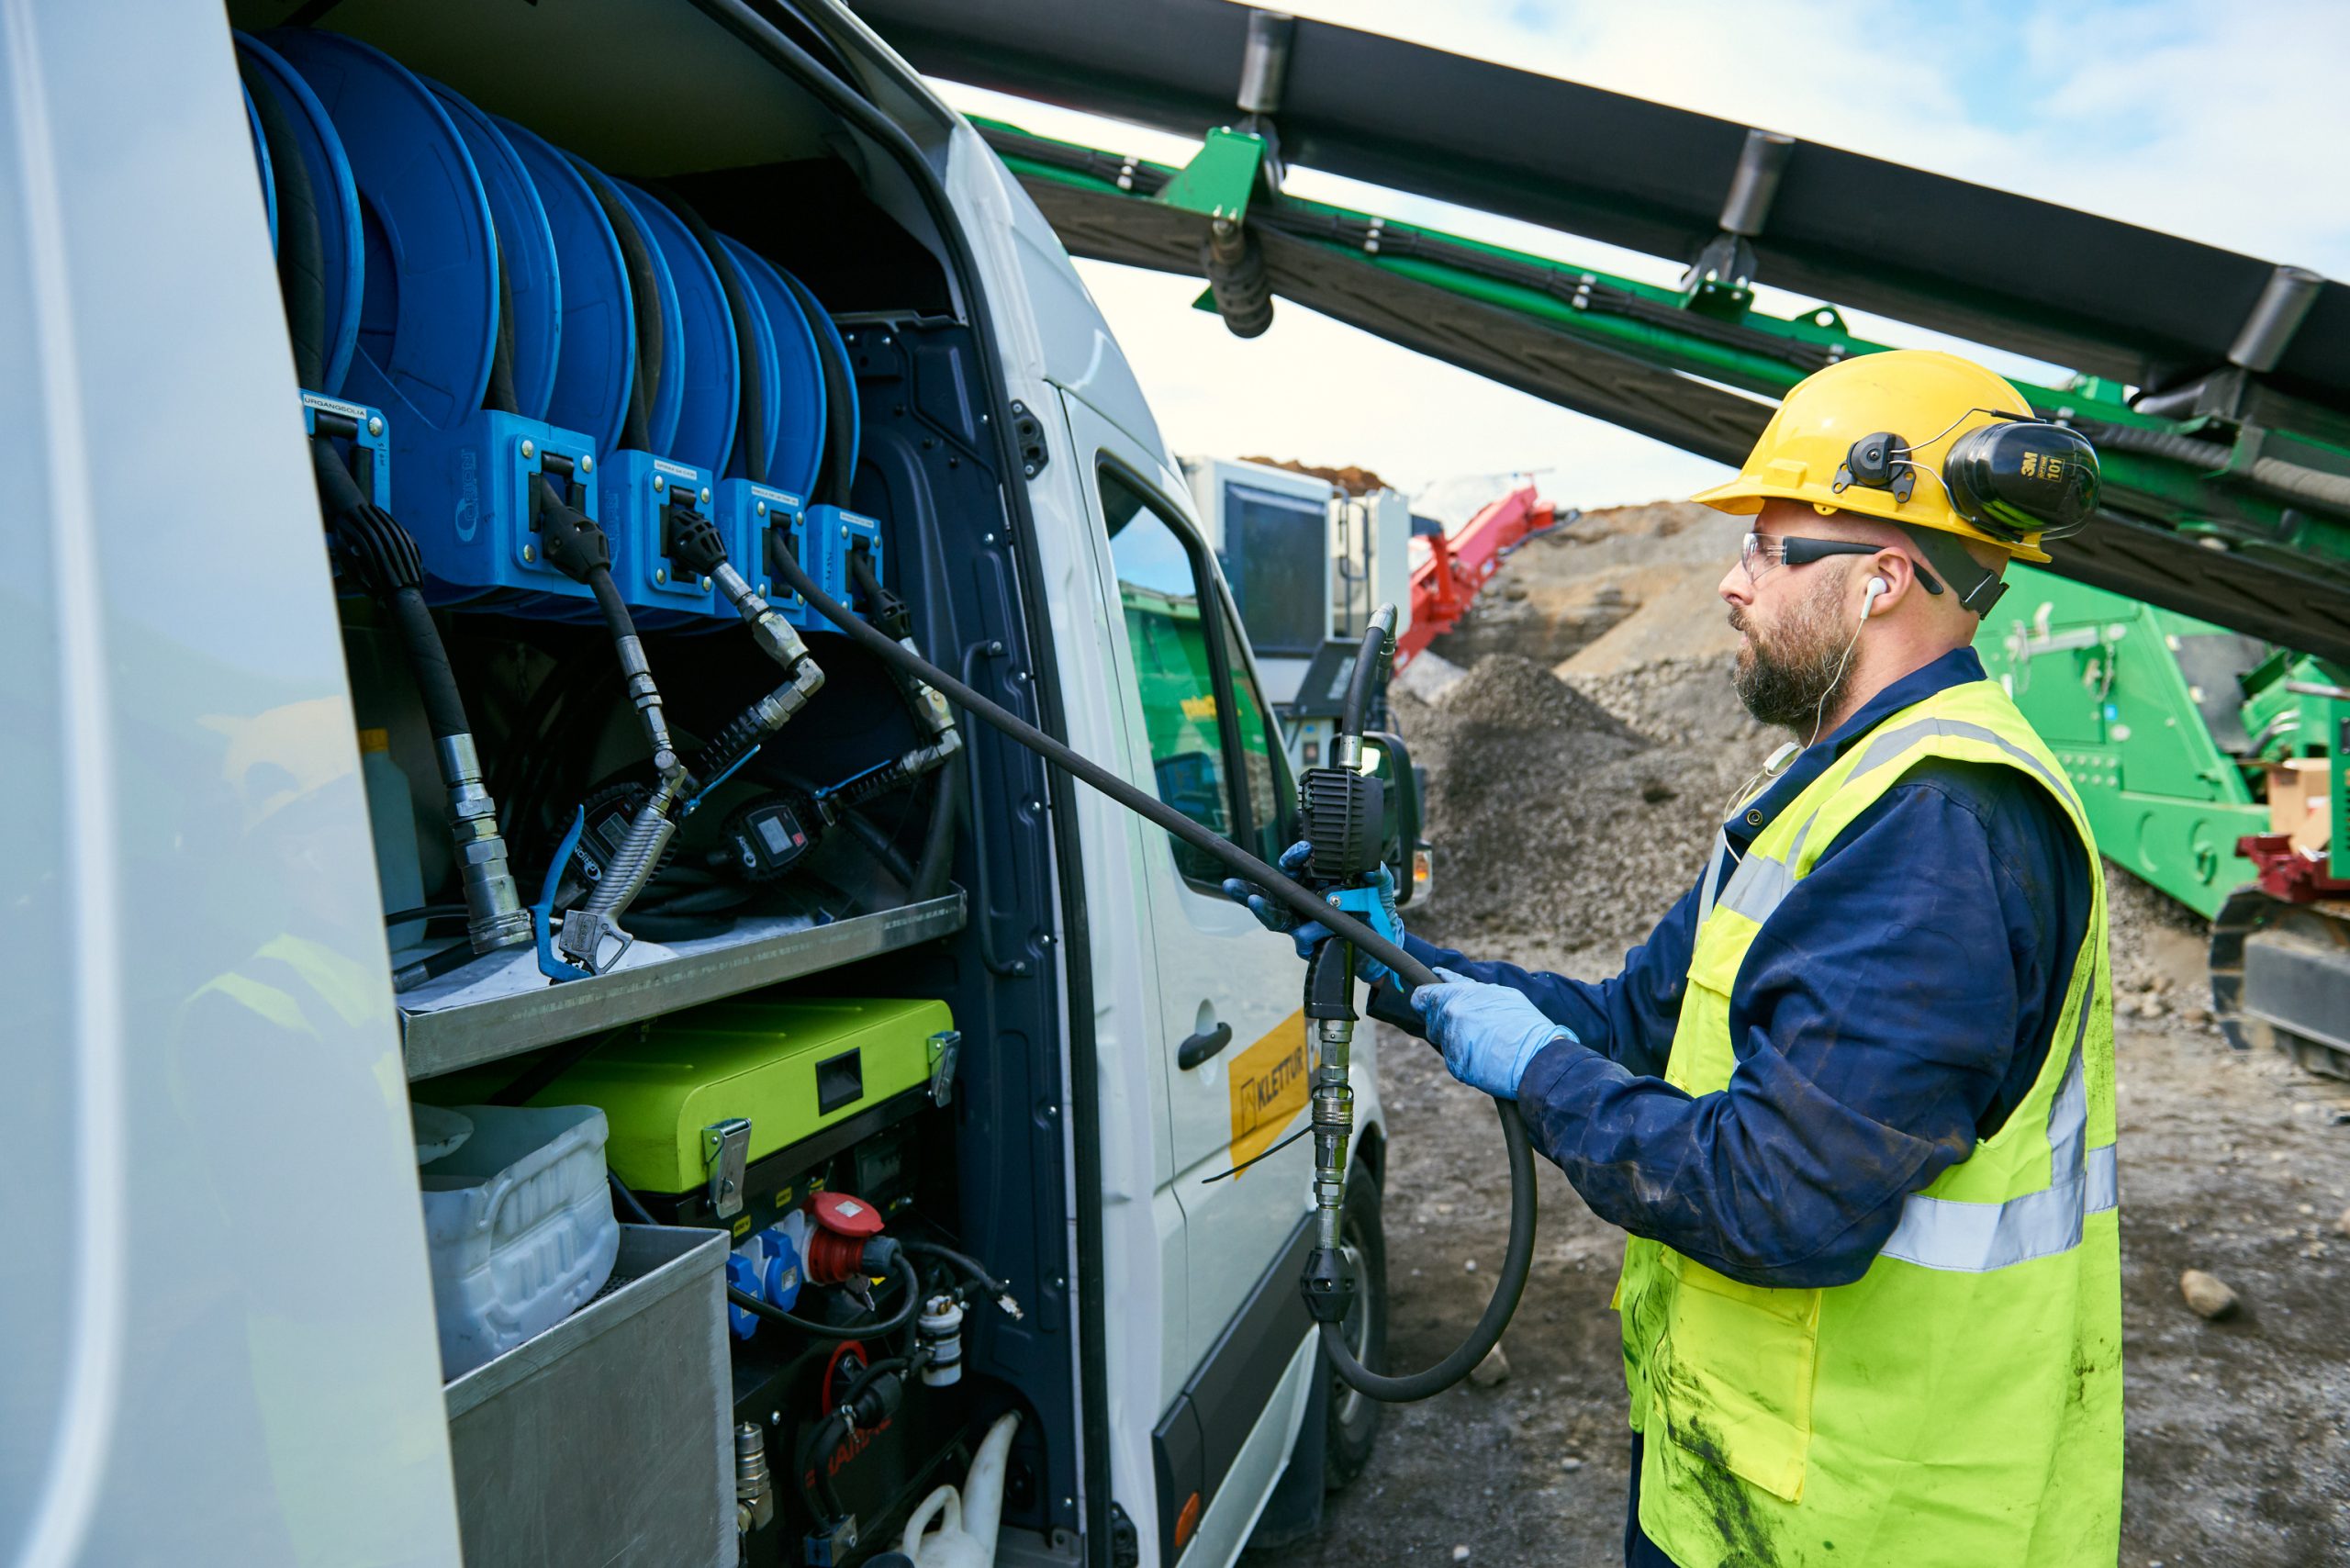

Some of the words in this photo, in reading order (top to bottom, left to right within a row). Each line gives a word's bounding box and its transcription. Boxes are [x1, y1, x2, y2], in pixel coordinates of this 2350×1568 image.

[2021, 452, 2038, 476] 3M
[2047, 458, 2062, 478] 101
[1258, 1046, 1304, 1112] KLETTUR
